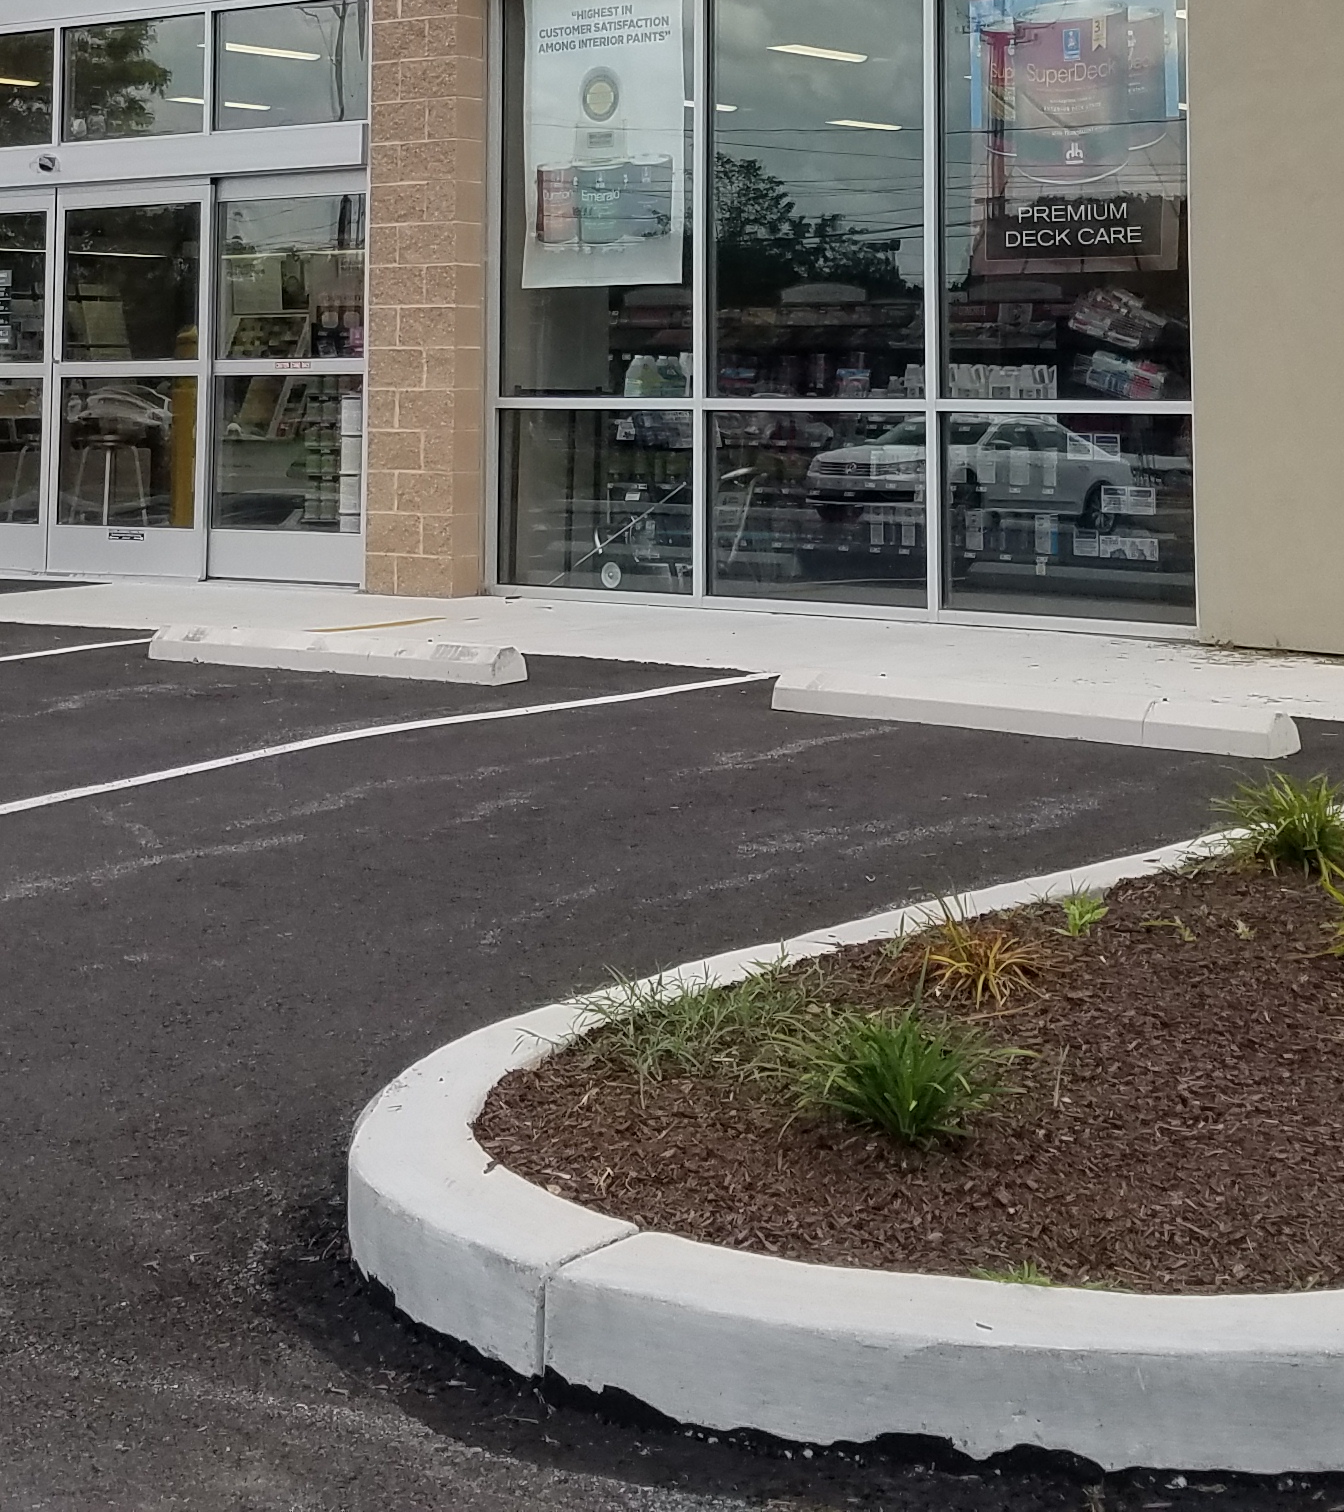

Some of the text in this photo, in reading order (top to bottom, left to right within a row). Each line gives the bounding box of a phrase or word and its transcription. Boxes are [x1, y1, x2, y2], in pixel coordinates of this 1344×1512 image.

[571, 4, 633, 20] "HIGHEST IN
[539, 16, 670, 39] CUSTOMER SATISFACTION
[538, 30, 671, 54] AMONG INTERIOR PAINTS"
[1026, 60, 1116, 87] SuperDeck
[581, 189, 620, 202] Emerald
[1017, 202, 1128, 224] PREMIUM
[1005, 226, 1143, 248] DECK CARE
